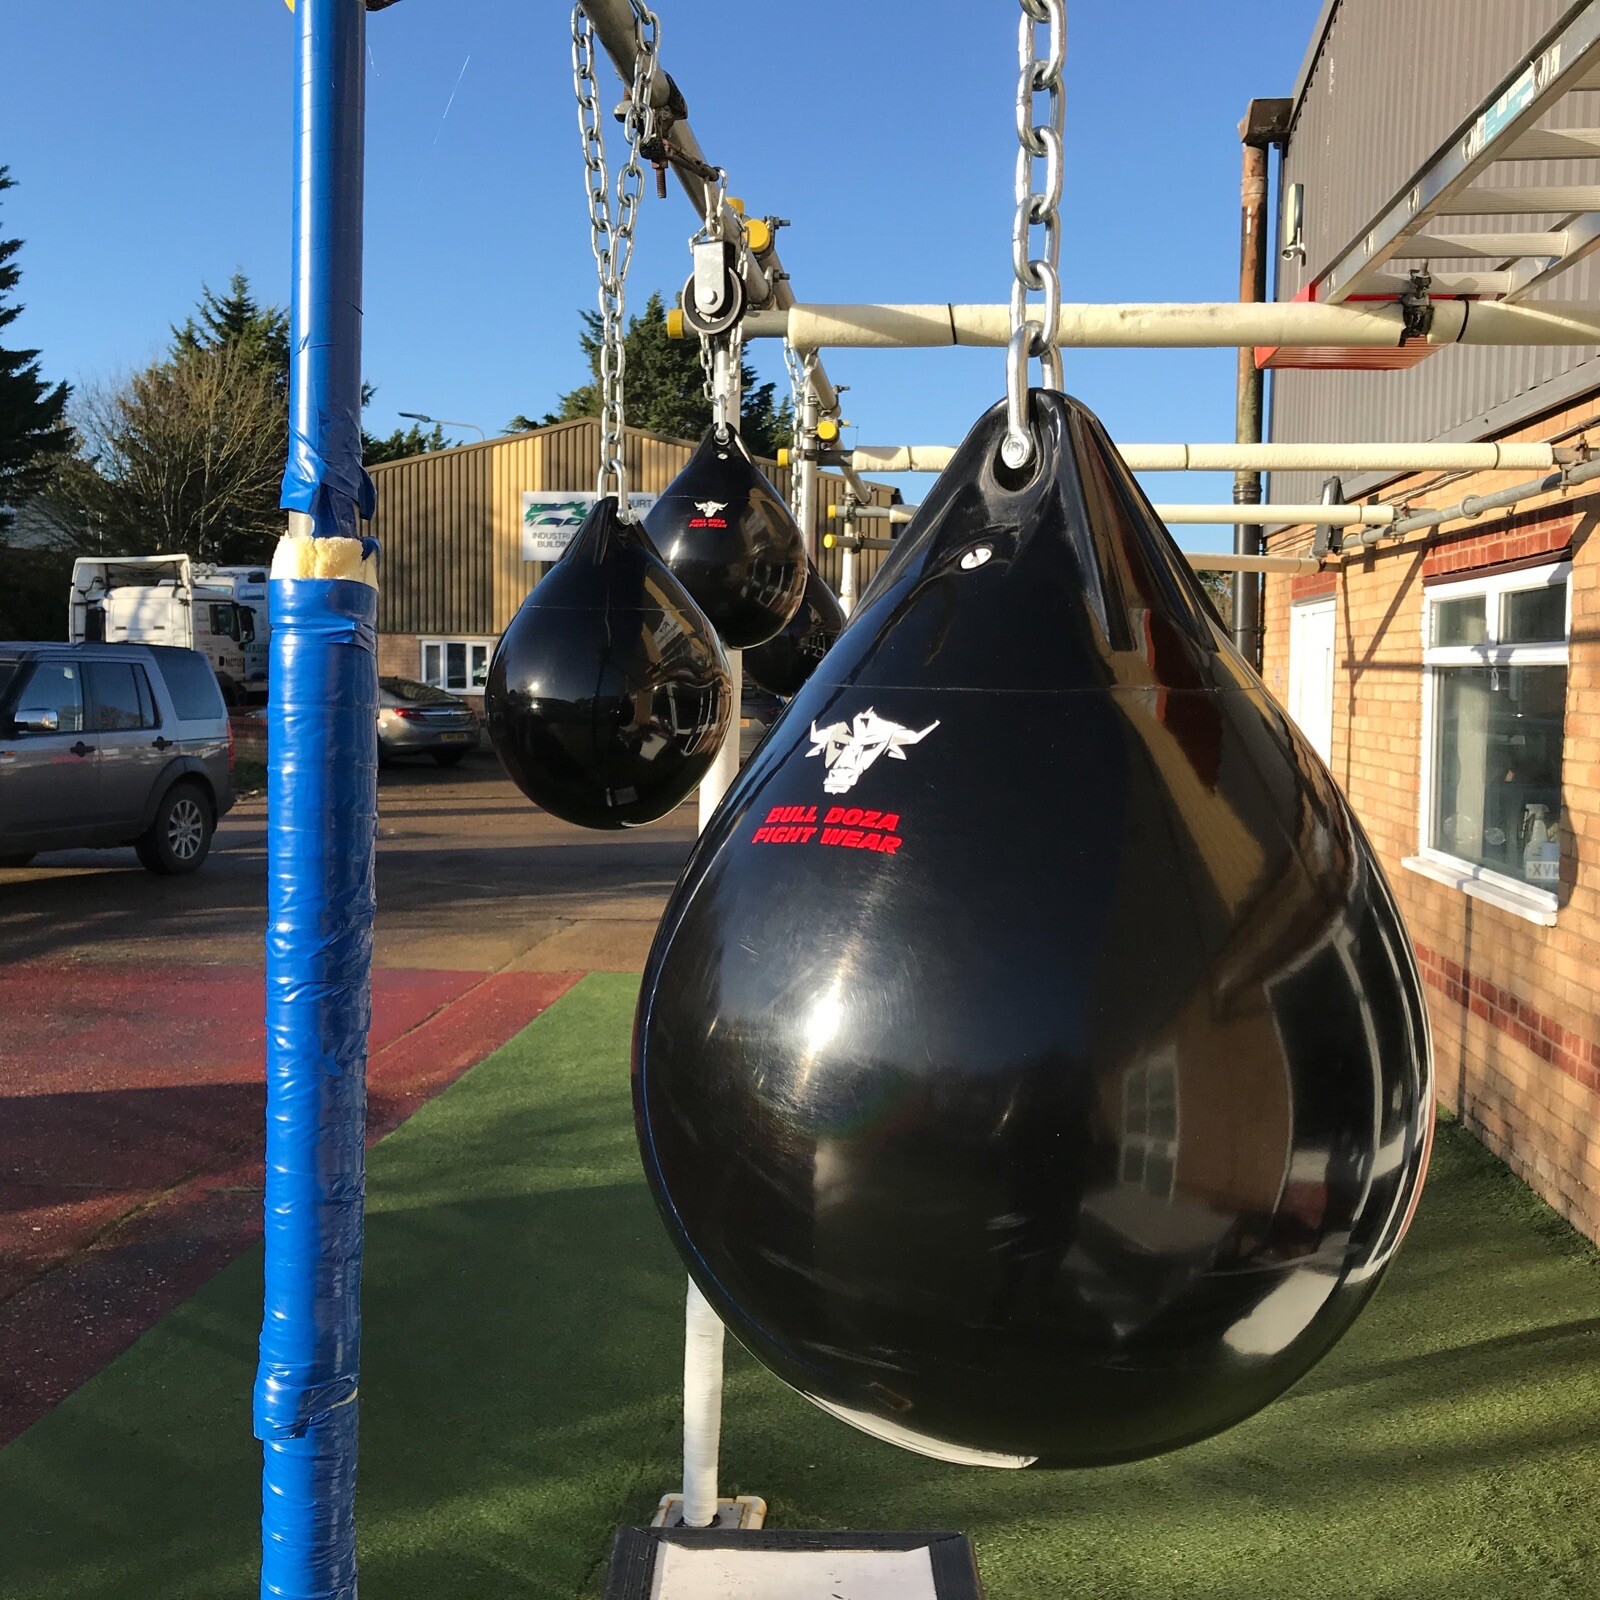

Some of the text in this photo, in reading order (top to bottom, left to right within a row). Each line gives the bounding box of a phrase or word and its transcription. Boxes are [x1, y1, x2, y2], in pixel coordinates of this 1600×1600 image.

[765, 805, 900, 831] BULL DOZA
[752, 826, 903, 855] FIGHT WEAR
